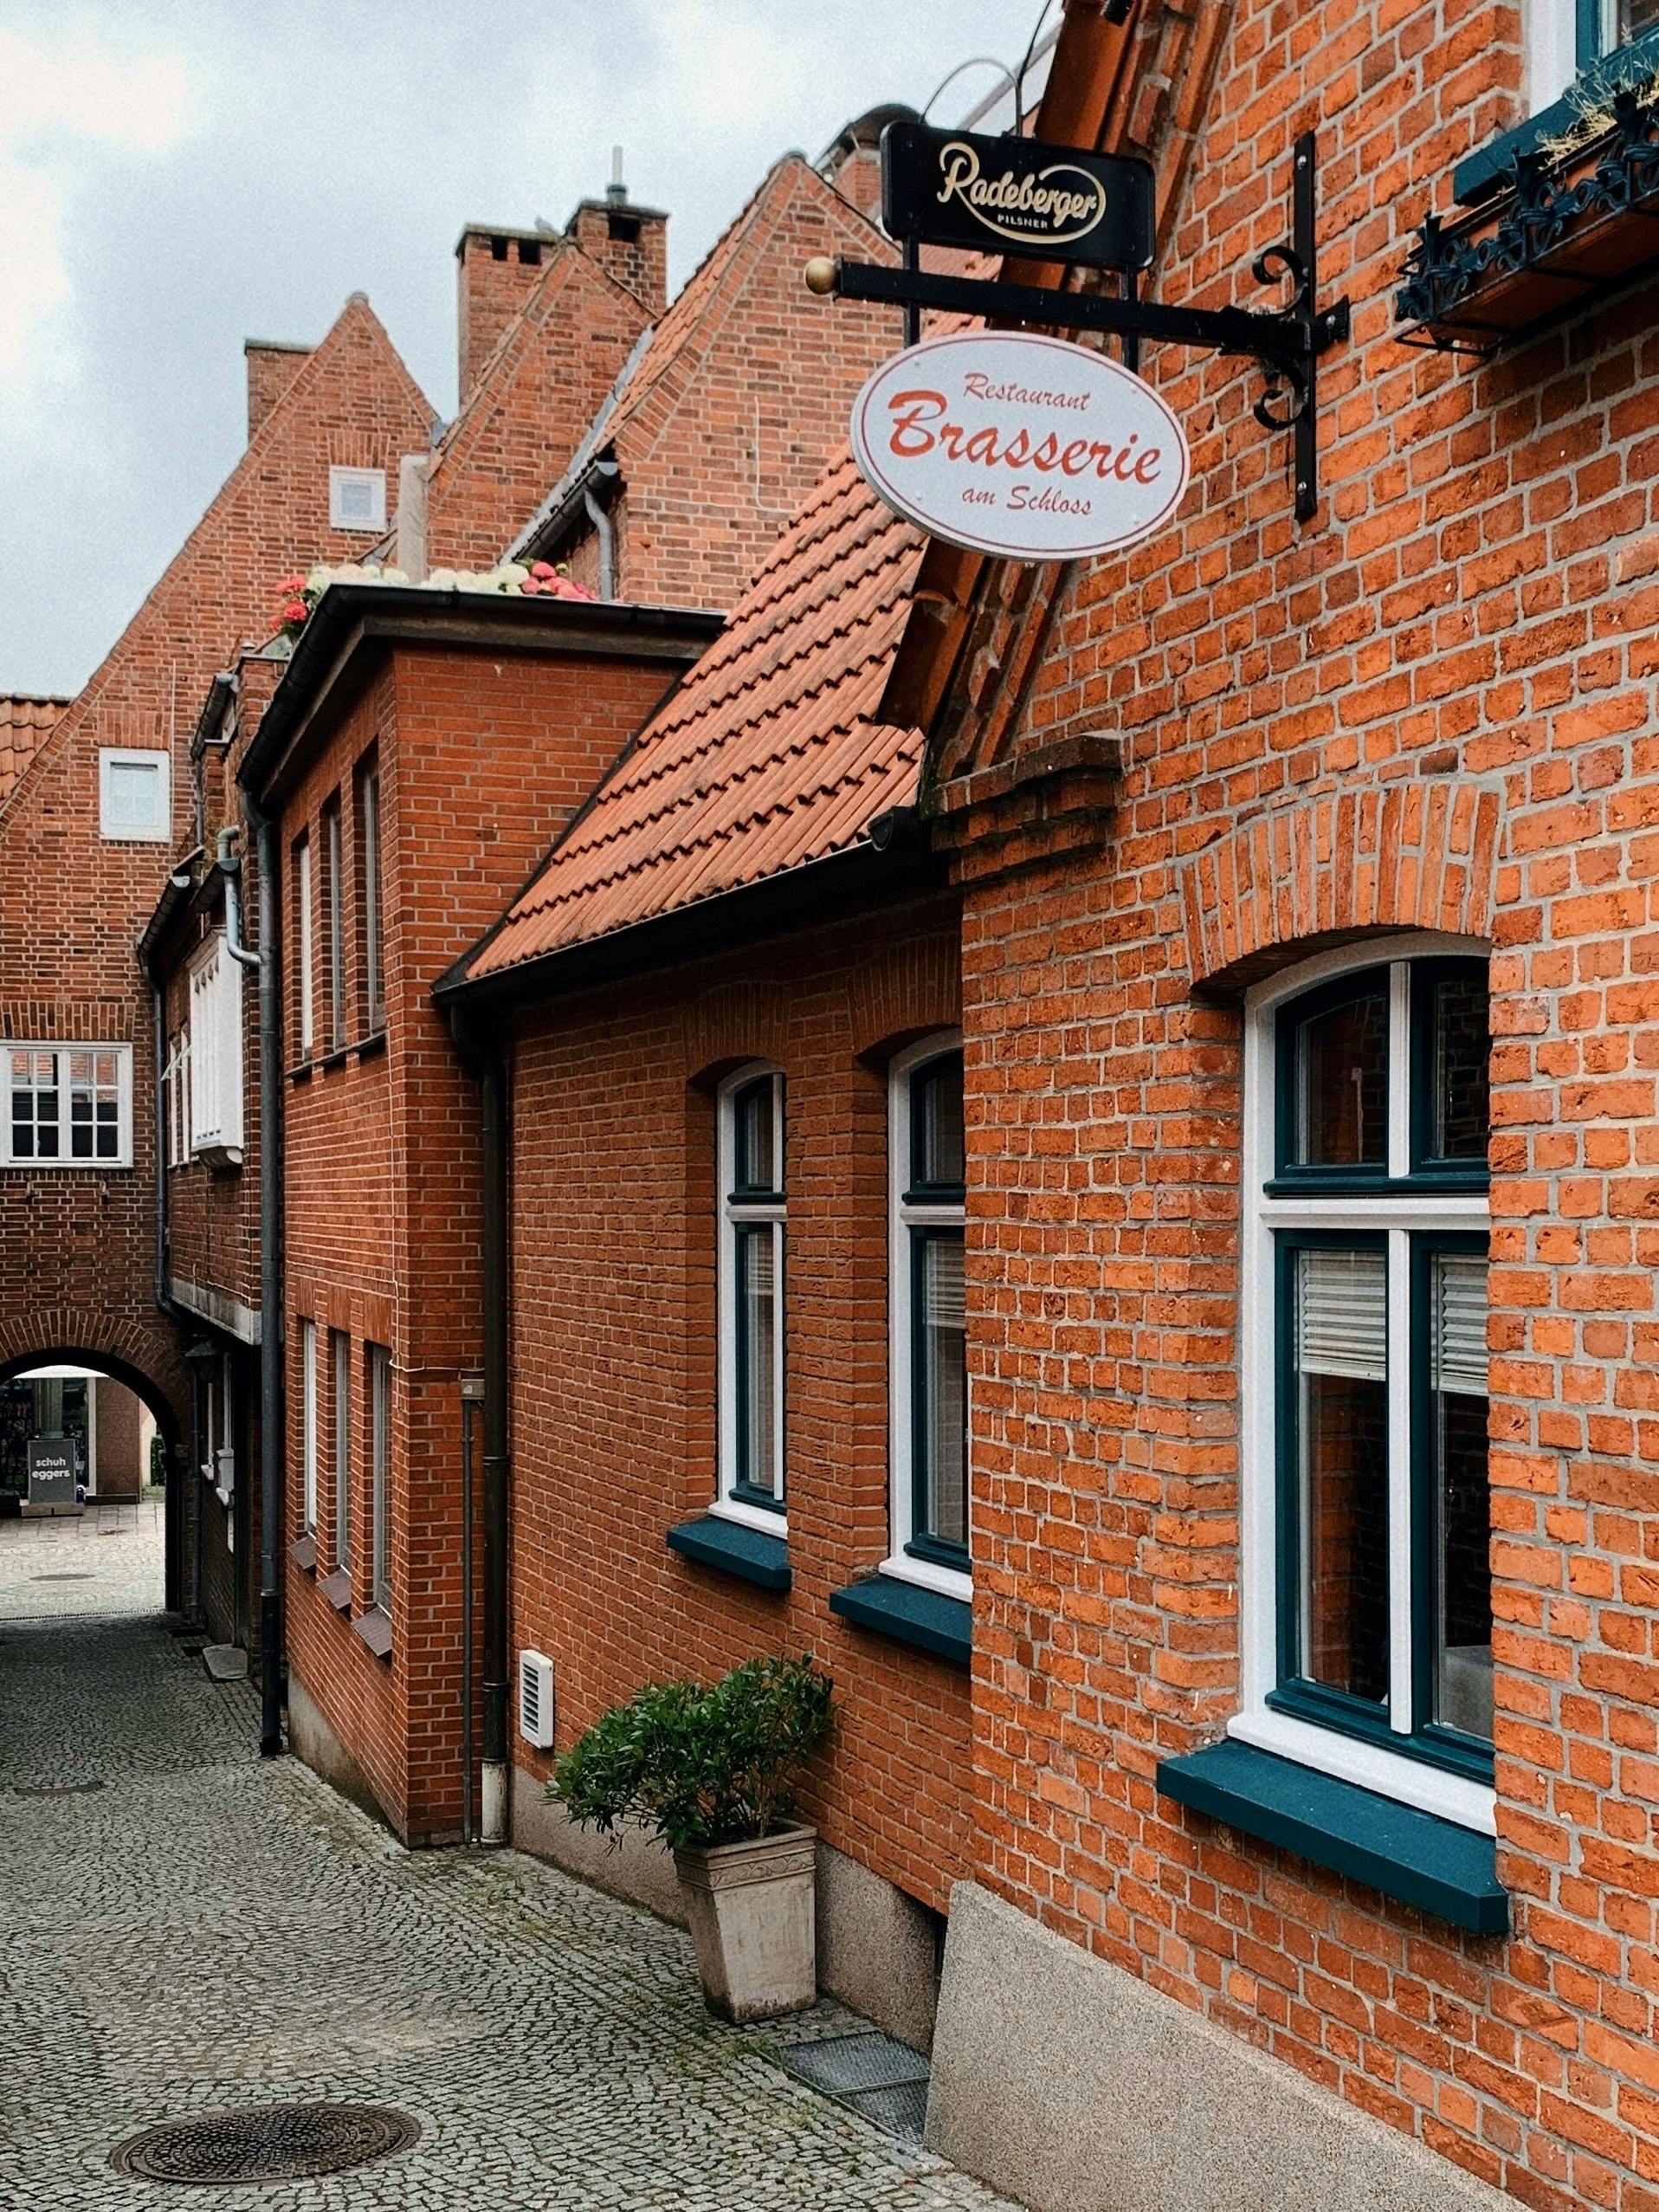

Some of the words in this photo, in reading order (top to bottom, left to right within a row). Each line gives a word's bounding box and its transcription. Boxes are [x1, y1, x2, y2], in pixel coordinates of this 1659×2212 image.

[937, 142, 1102, 230] Radeberger
[997, 214, 1049, 230] PILSNER
[963, 372, 1091, 411] Restaurant
[888, 390, 1161, 484] Brasserie
[961, 487, 997, 506] am
[1005, 485, 1093, 515] Schloss
[32, 1470, 70, 1480] eggers
[36, 1457, 66, 1466] schuh
